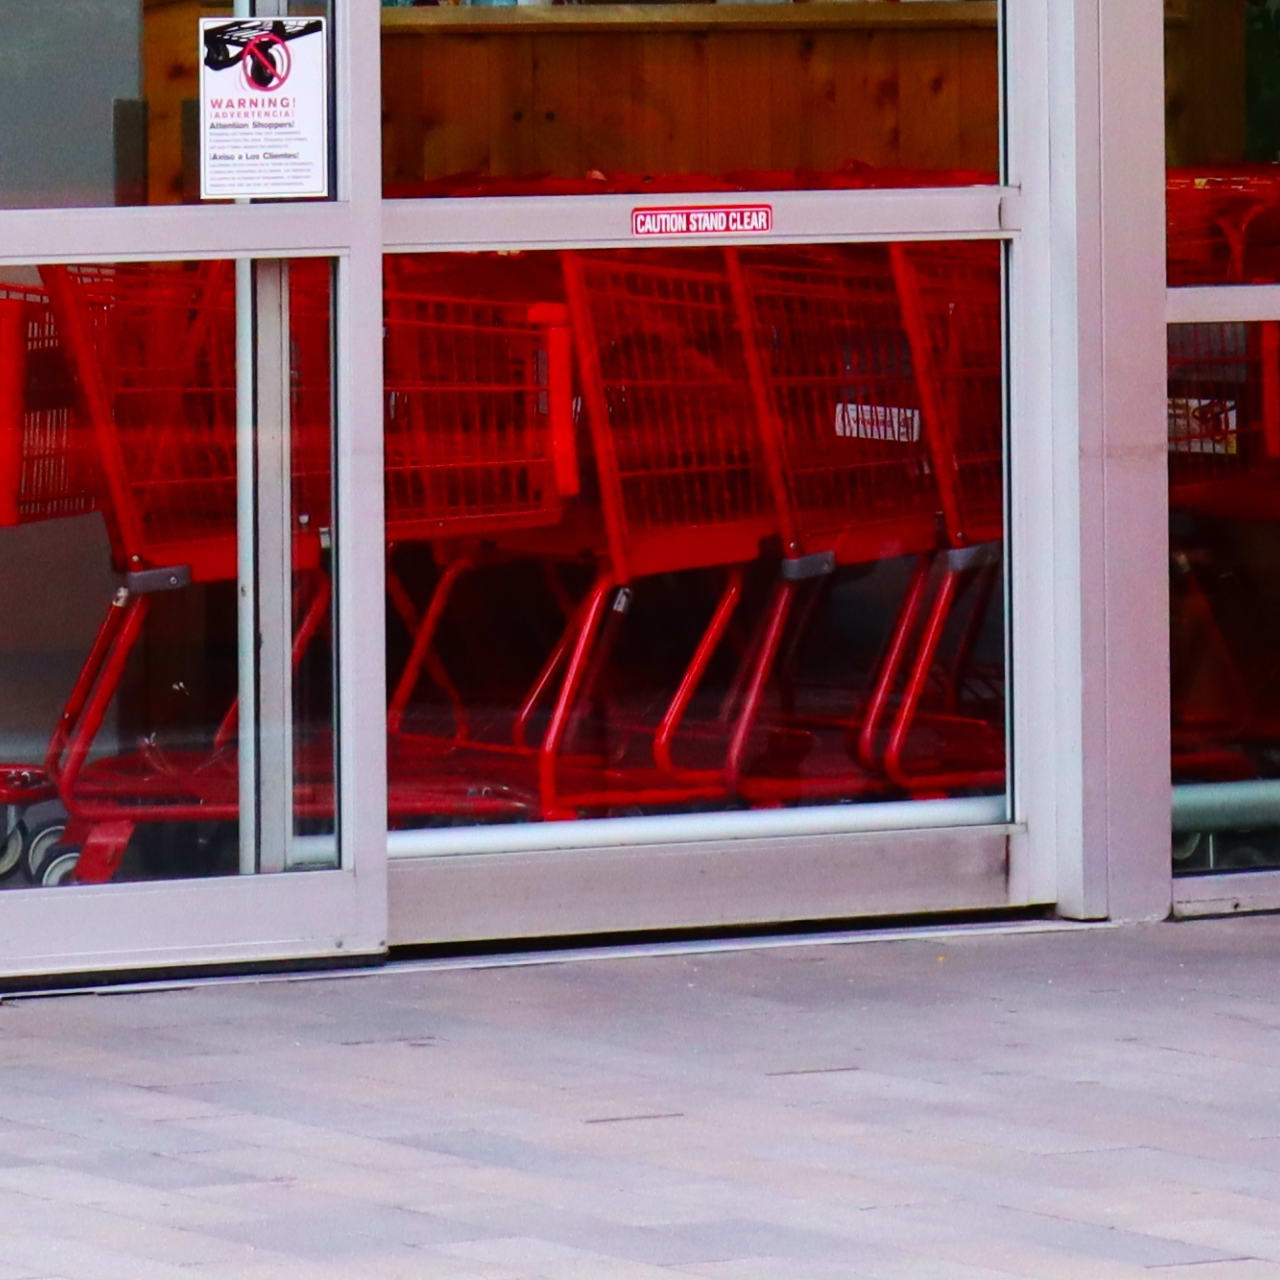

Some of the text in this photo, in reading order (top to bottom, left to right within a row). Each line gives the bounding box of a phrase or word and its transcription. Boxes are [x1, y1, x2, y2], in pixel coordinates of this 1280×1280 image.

[210, 97, 296, 109] WARNING!
[636, 211, 767, 233] CAUTION STAND CLEAR
